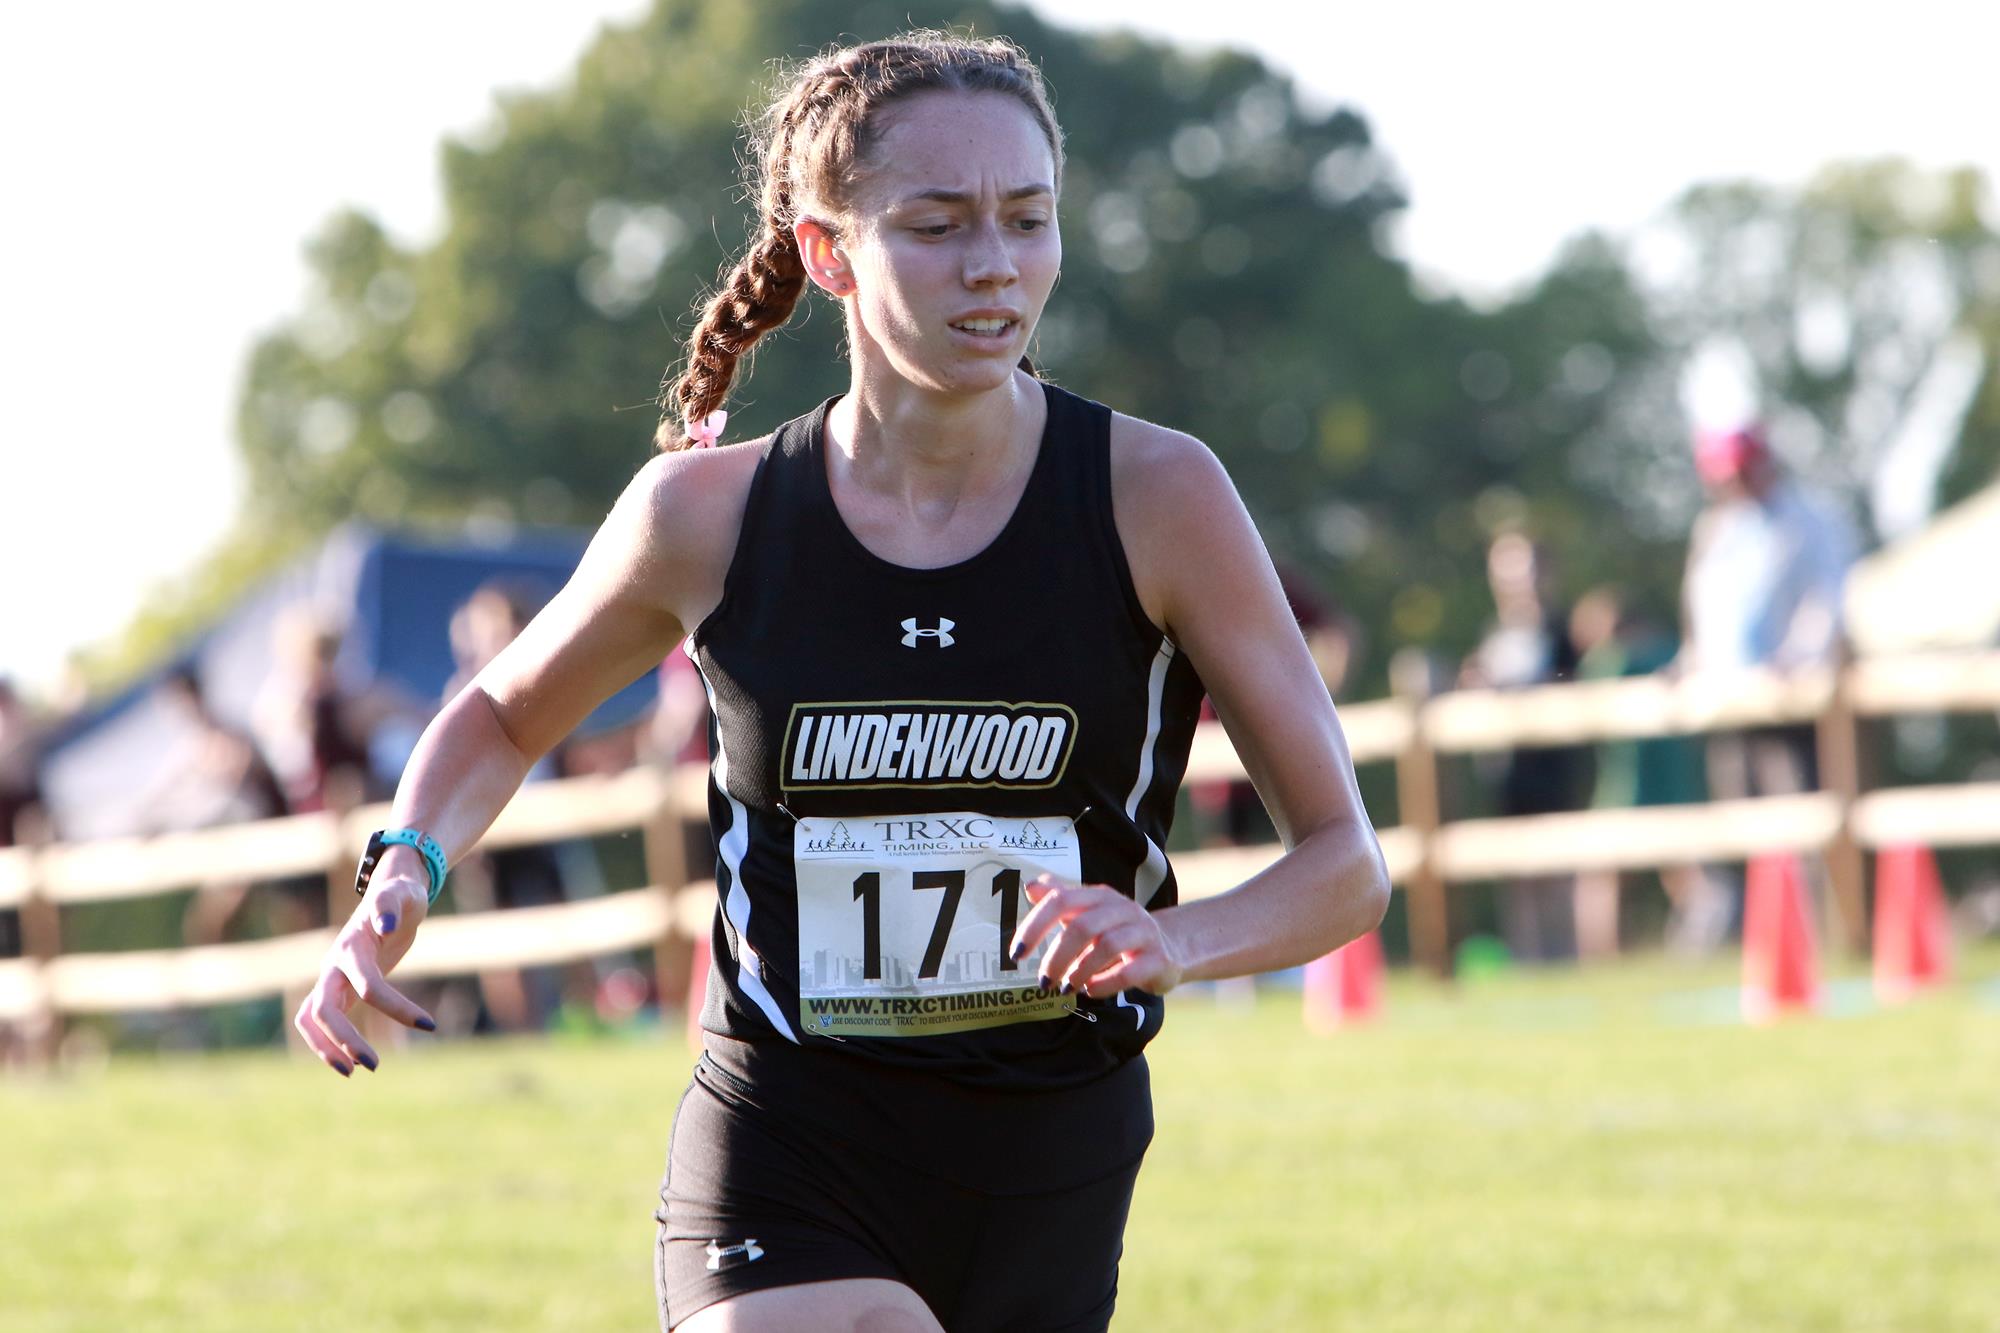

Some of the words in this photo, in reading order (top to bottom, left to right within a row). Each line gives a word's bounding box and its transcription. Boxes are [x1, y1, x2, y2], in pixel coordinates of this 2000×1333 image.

[792, 713, 1066, 780] LINDENWOOD
[874, 818, 994, 841] TRXC
[882, 842, 954, 851] TIMING,
[961, 841, 990, 849] LLC
[853, 869, 1021, 980] 171
[832, 1017, 844, 1025] USE
[844, 1017, 873, 1025] DISCOUNT
[874, 1018, 892, 1026] CODE
[952, 1013, 968, 1022] YOUR
[968, 1010, 997, 1020] DISCOUNT
